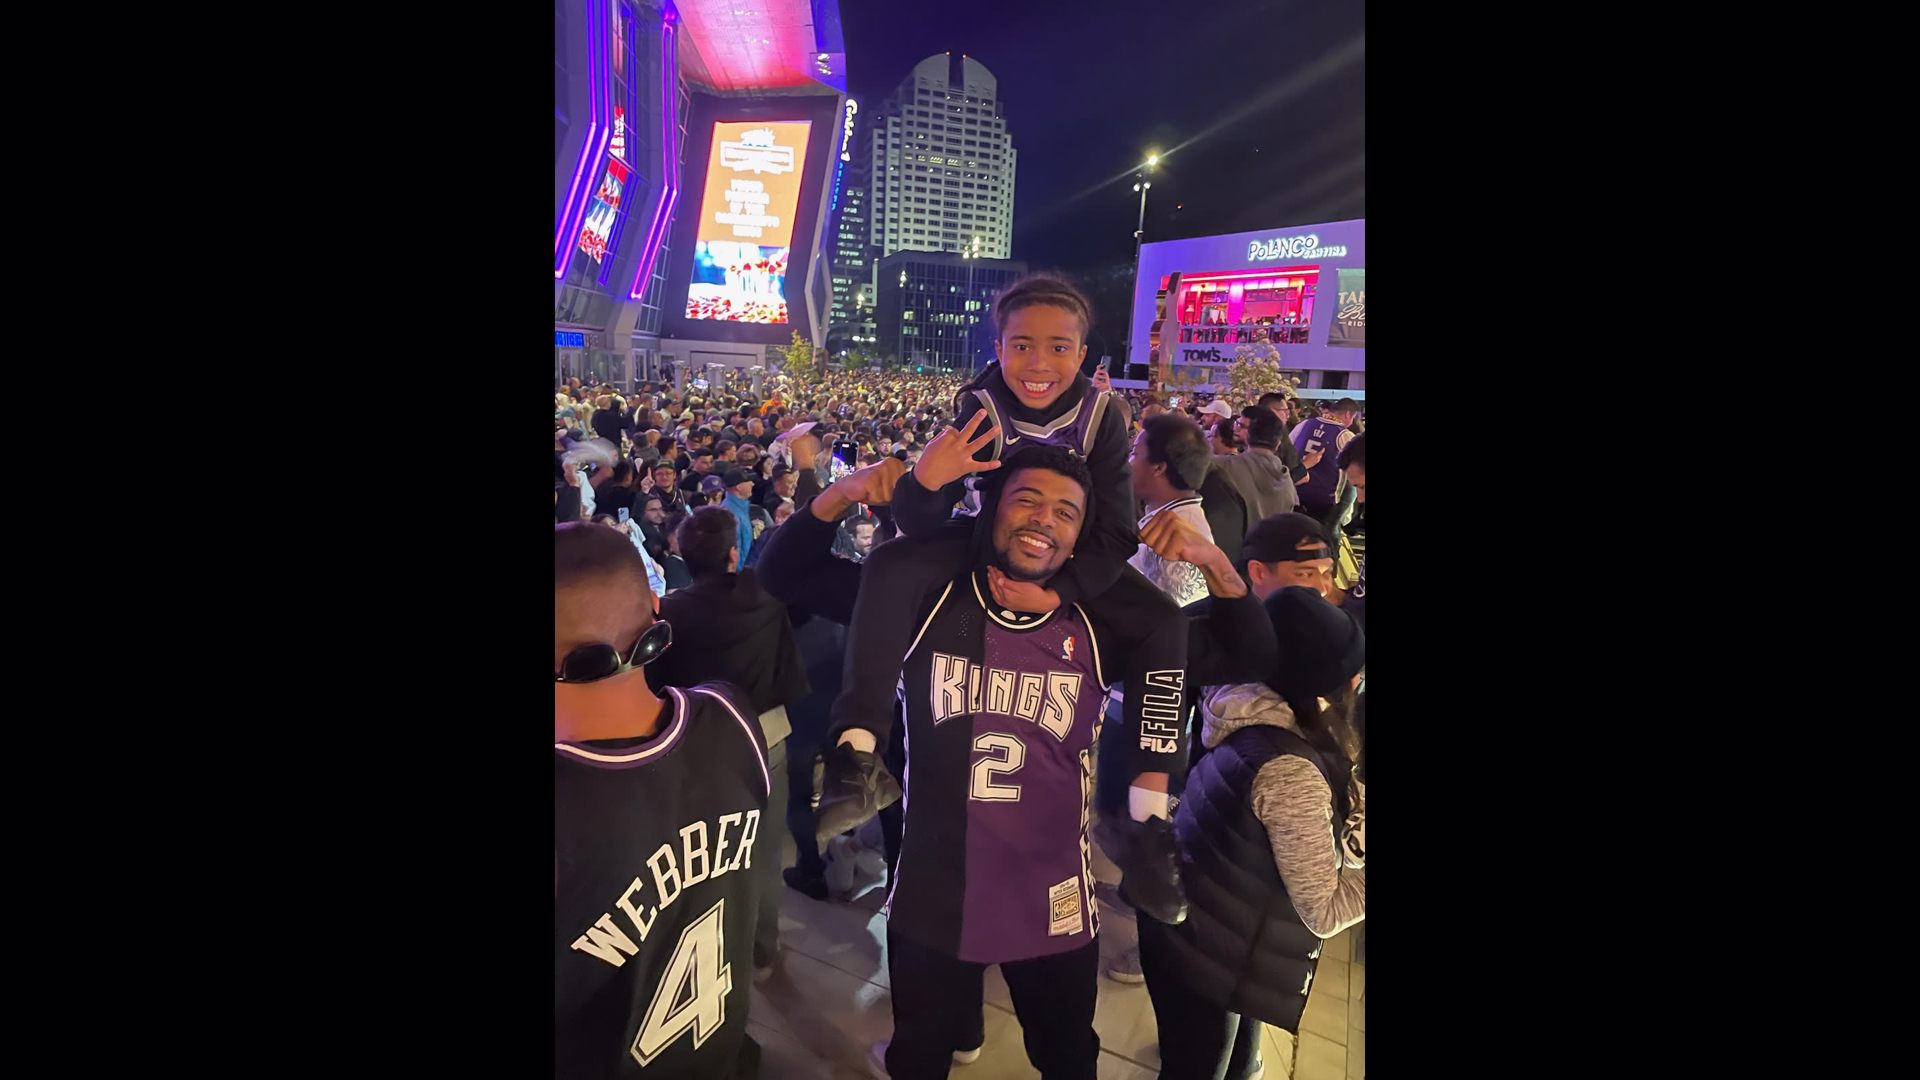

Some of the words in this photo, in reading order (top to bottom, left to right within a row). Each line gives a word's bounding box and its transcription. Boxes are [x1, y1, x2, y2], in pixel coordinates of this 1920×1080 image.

[1183, 347, 1221, 362] TOM'S
[931, 651, 1083, 742] KINGS
[1141, 670, 1184, 739] FILA
[969, 732, 1026, 801] 2
[1140, 736, 1178, 754] FILA
[570, 809, 760, 968] WEBBER
[630, 898, 732, 1067] 4
